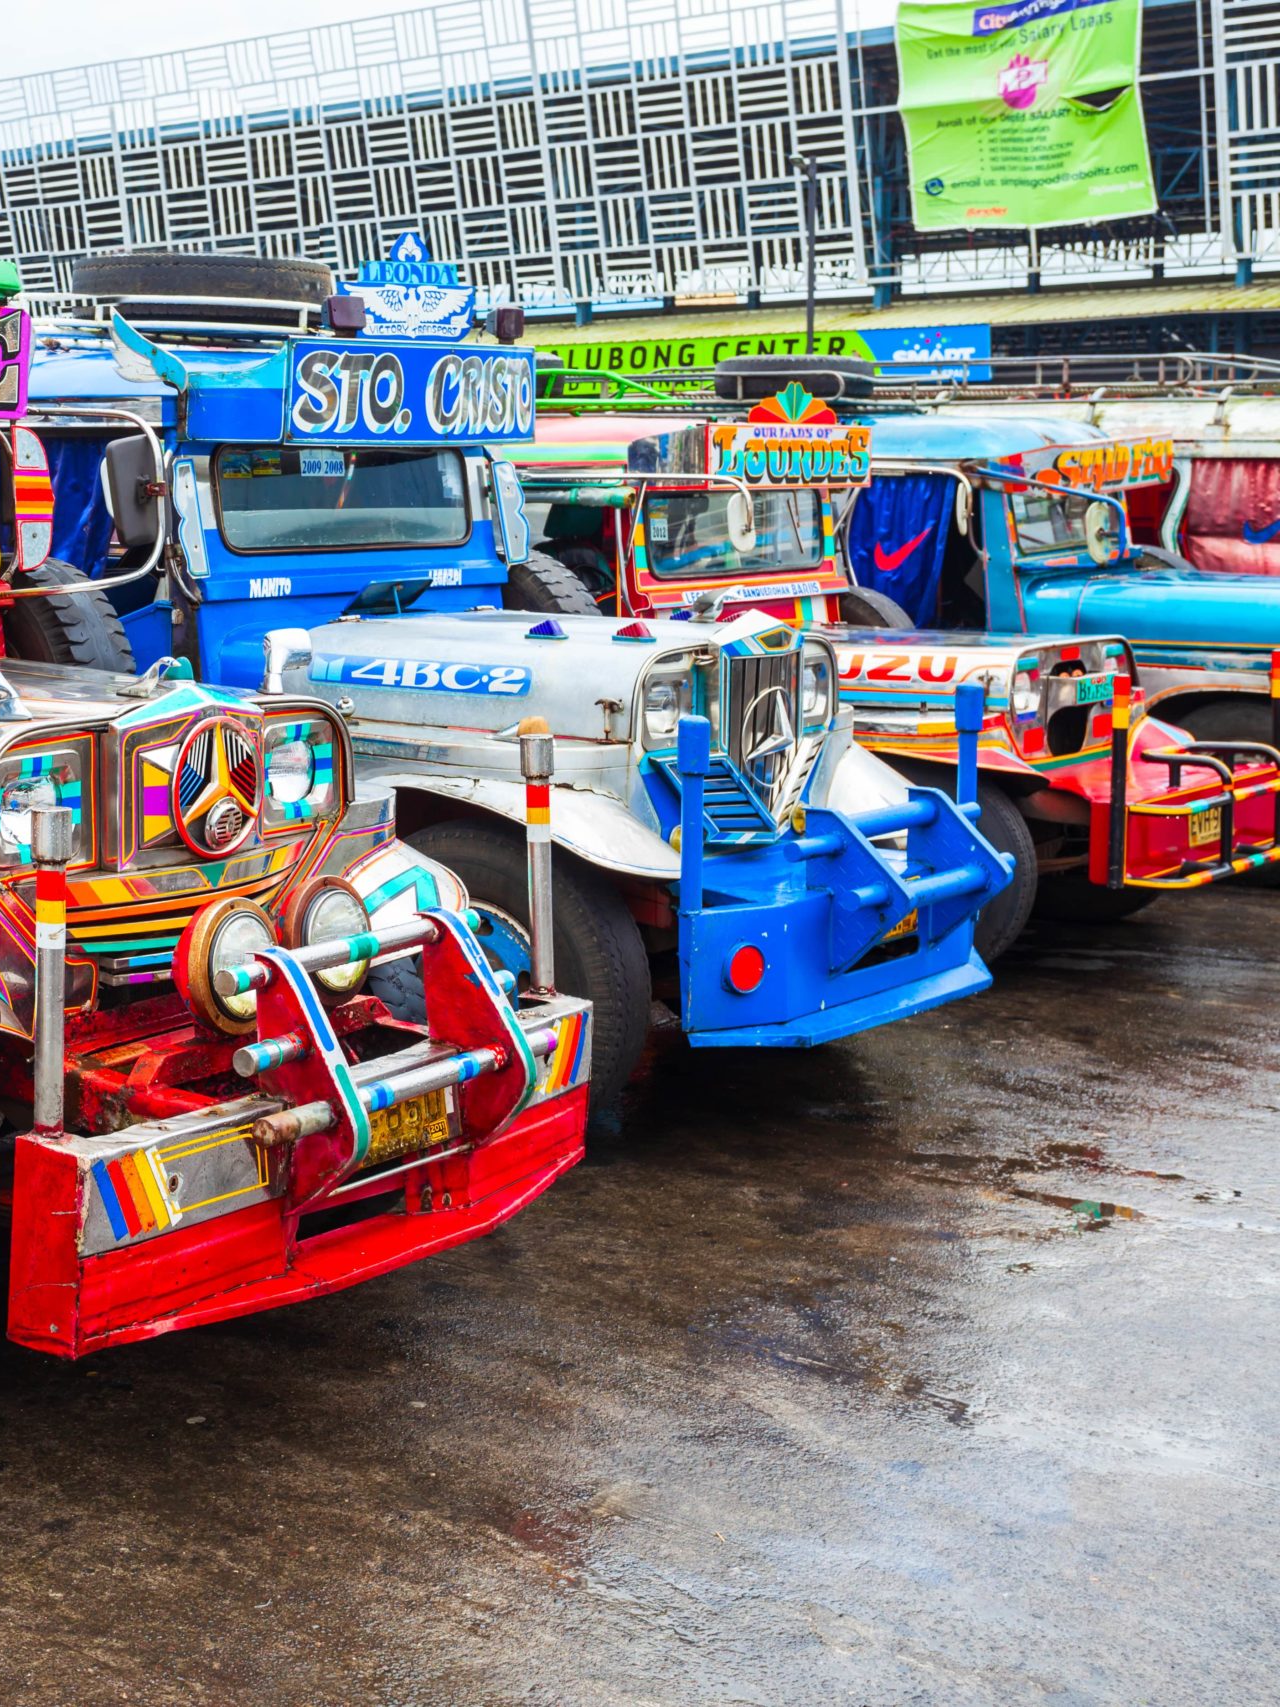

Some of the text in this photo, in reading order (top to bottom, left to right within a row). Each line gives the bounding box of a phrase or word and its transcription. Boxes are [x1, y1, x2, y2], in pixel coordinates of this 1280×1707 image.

[369, 324, 460, 336] VICTORY TRANSPORT
[292, 350, 533, 435] STO. CRISTO
[753, 427, 778, 438] OUR
[817, 427, 832, 439] OF
[713, 427, 870, 483] LOURDES
[302, 460, 344, 475] 2009 2008
[250, 577, 291, 599] MANITO
[837, 654, 959, 683] UZU
[430, 1122, 445, 1133] 2011
